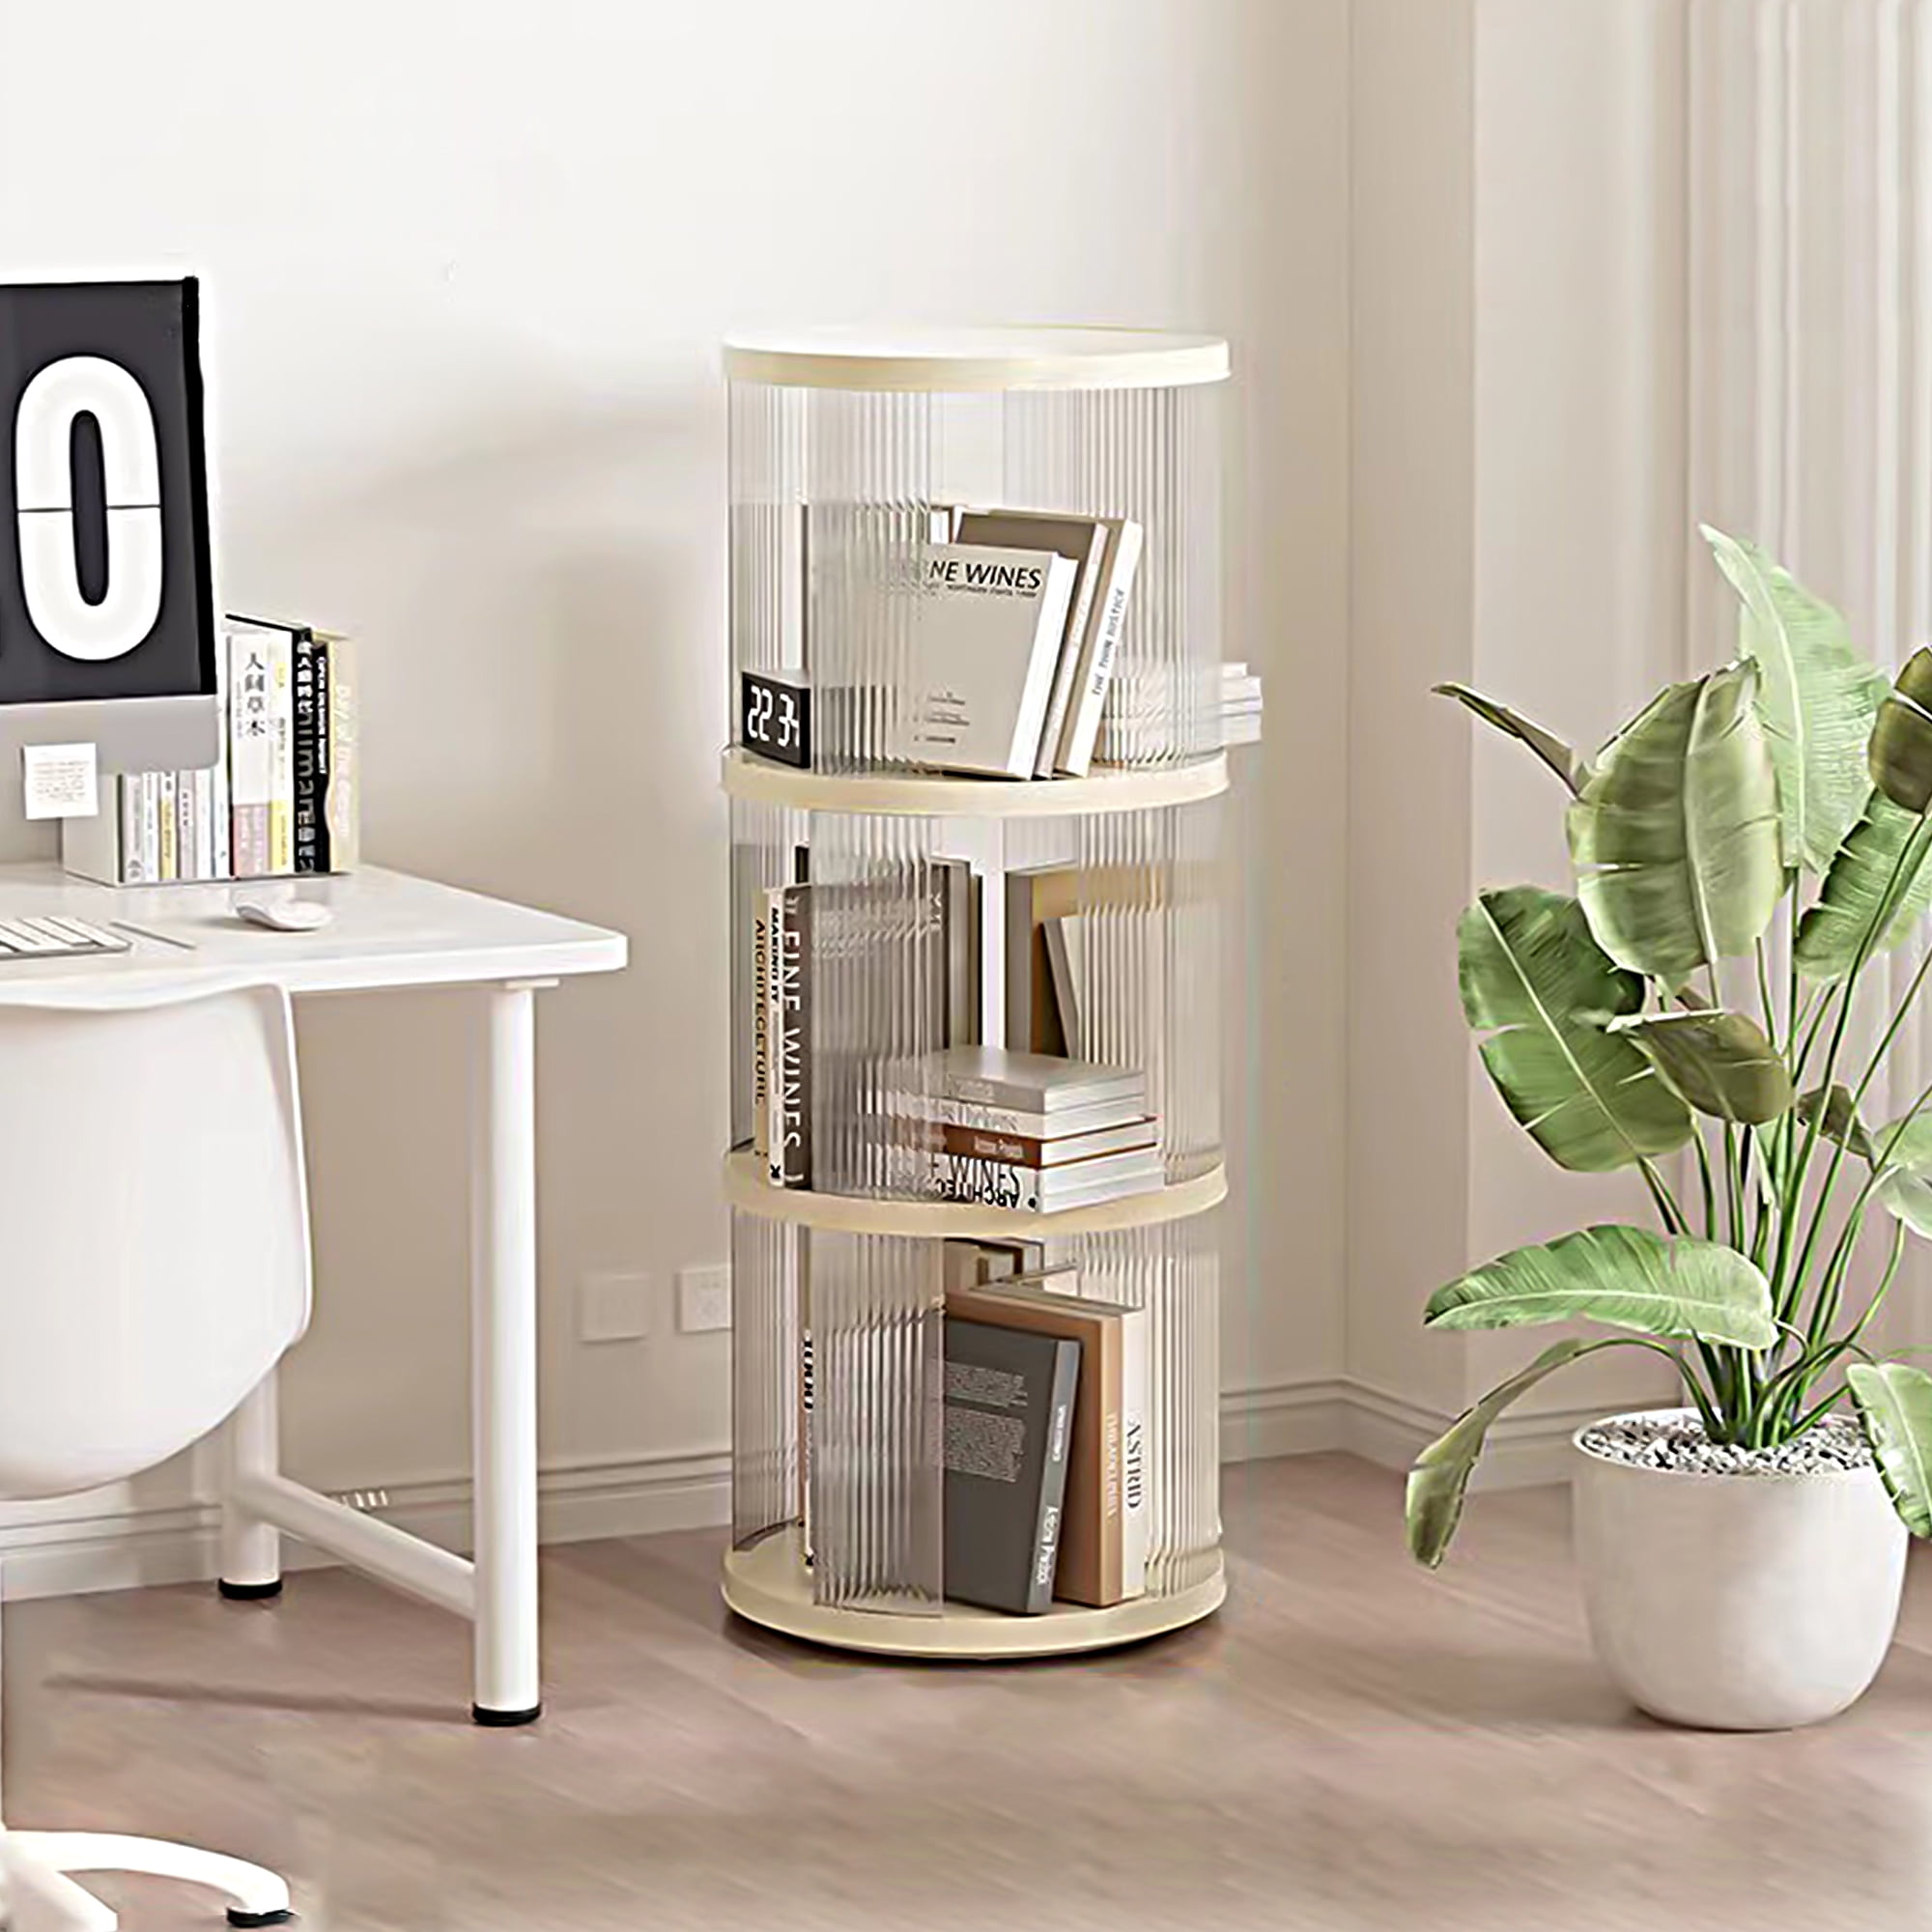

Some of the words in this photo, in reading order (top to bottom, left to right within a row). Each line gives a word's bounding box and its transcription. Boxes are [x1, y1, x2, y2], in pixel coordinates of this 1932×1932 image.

[15, 355, 163, 661] 0
[966, 563, 1041, 589] WINES
[748, 685, 773, 742] 22
[783, 931, 801, 1011] FINE
[783, 1028, 802, 1148] WINES
[1126, 1419, 1142, 1509] ASTRID
